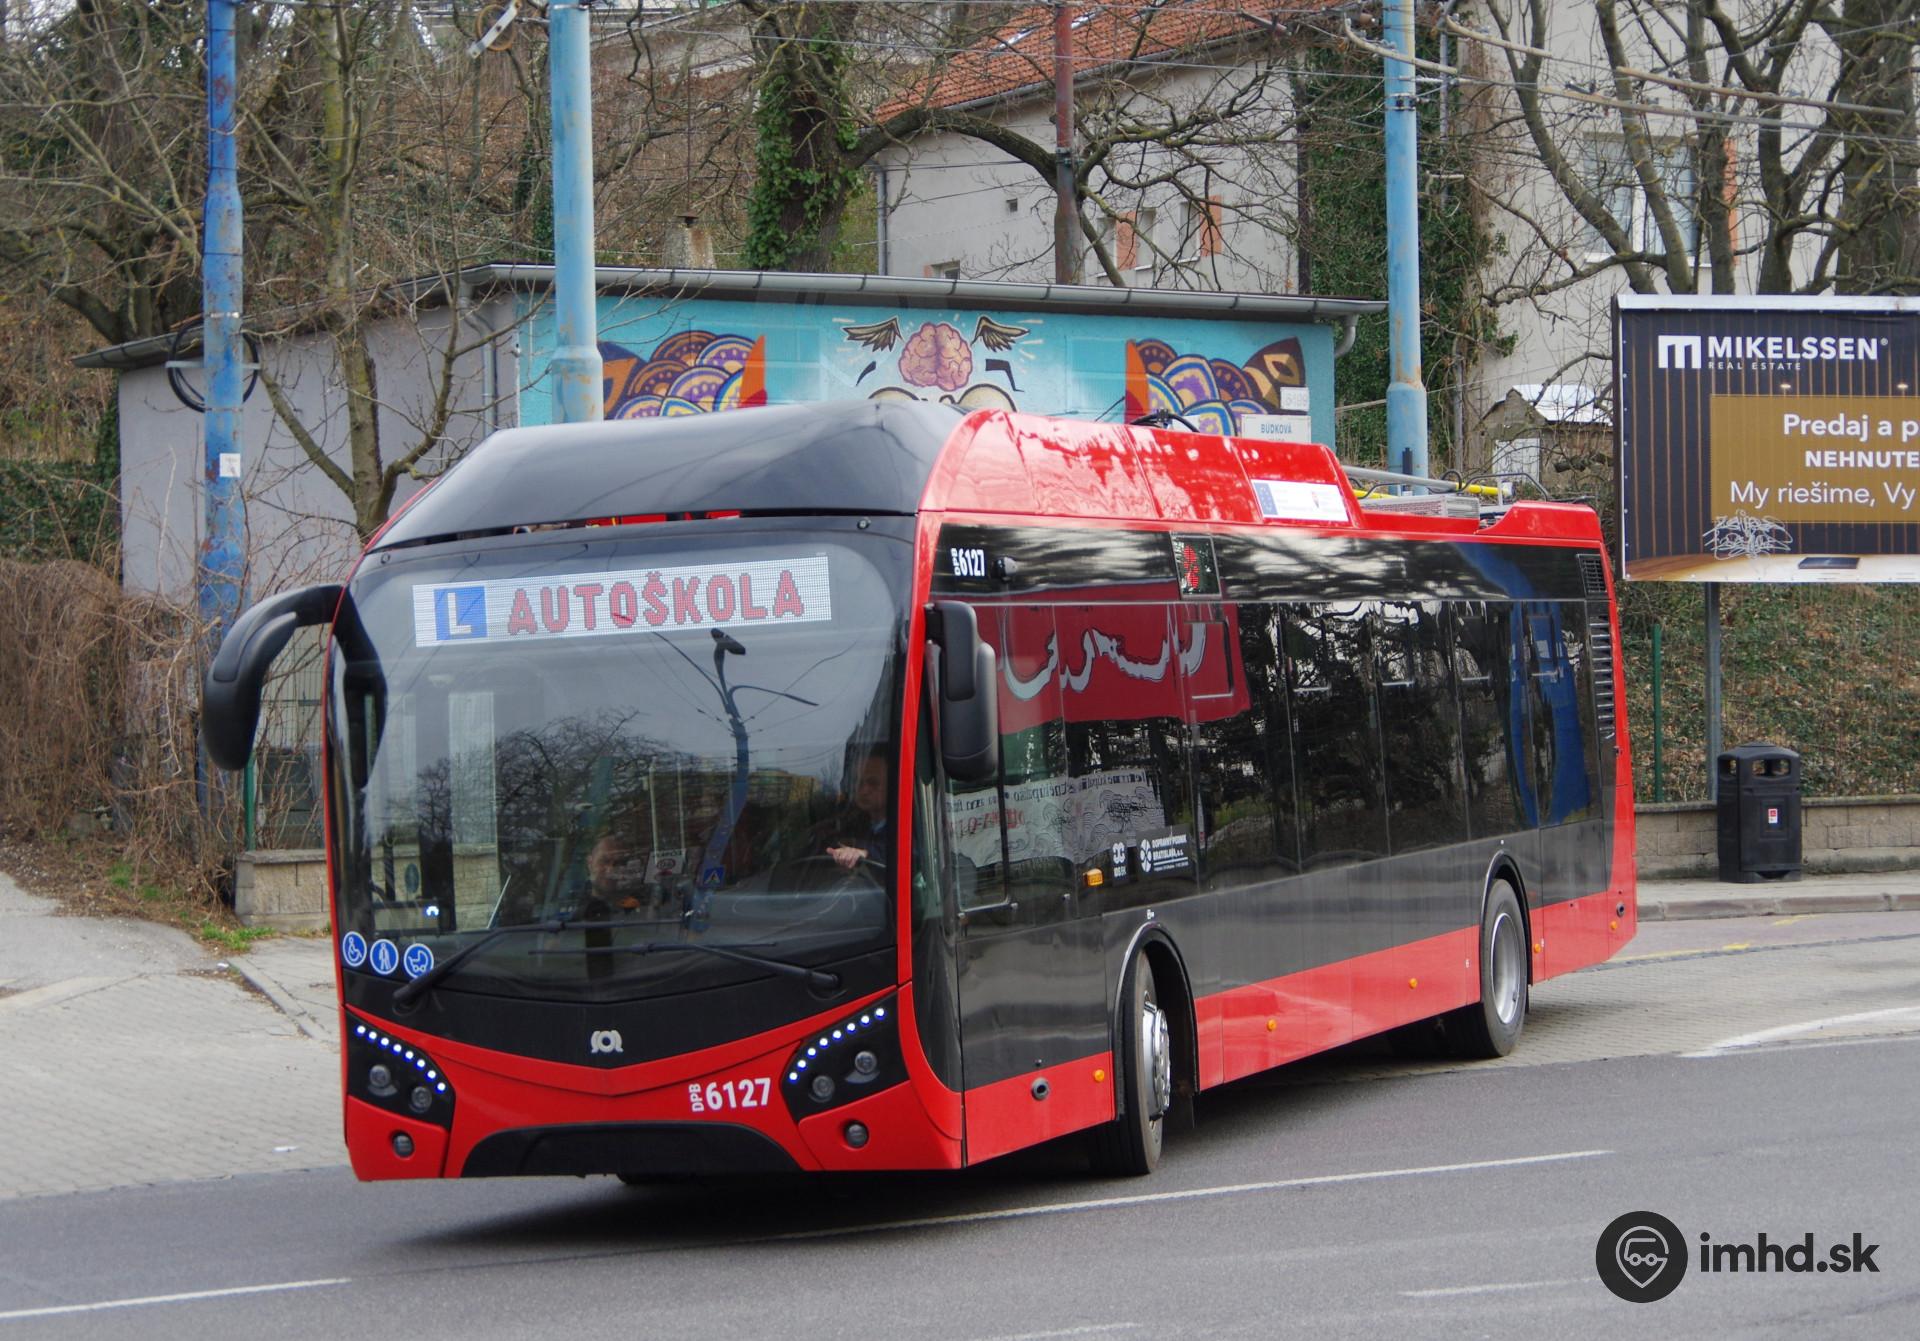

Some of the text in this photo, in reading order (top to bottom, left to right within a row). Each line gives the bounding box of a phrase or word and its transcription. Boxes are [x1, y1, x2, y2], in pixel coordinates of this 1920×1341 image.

[1708, 361, 1802, 371] REAL ESTATE
[1783, 412, 1869, 443] Predaj
[1877, 419, 1893, 436] a
[1730, 480, 1916, 510] My riešime, Vy
[958, 547, 985, 577] 6127
[446, 569, 805, 637] L AUTOŠKOLA
[688, 1083, 704, 1113] DPB
[705, 1077, 771, 1111] 6127
